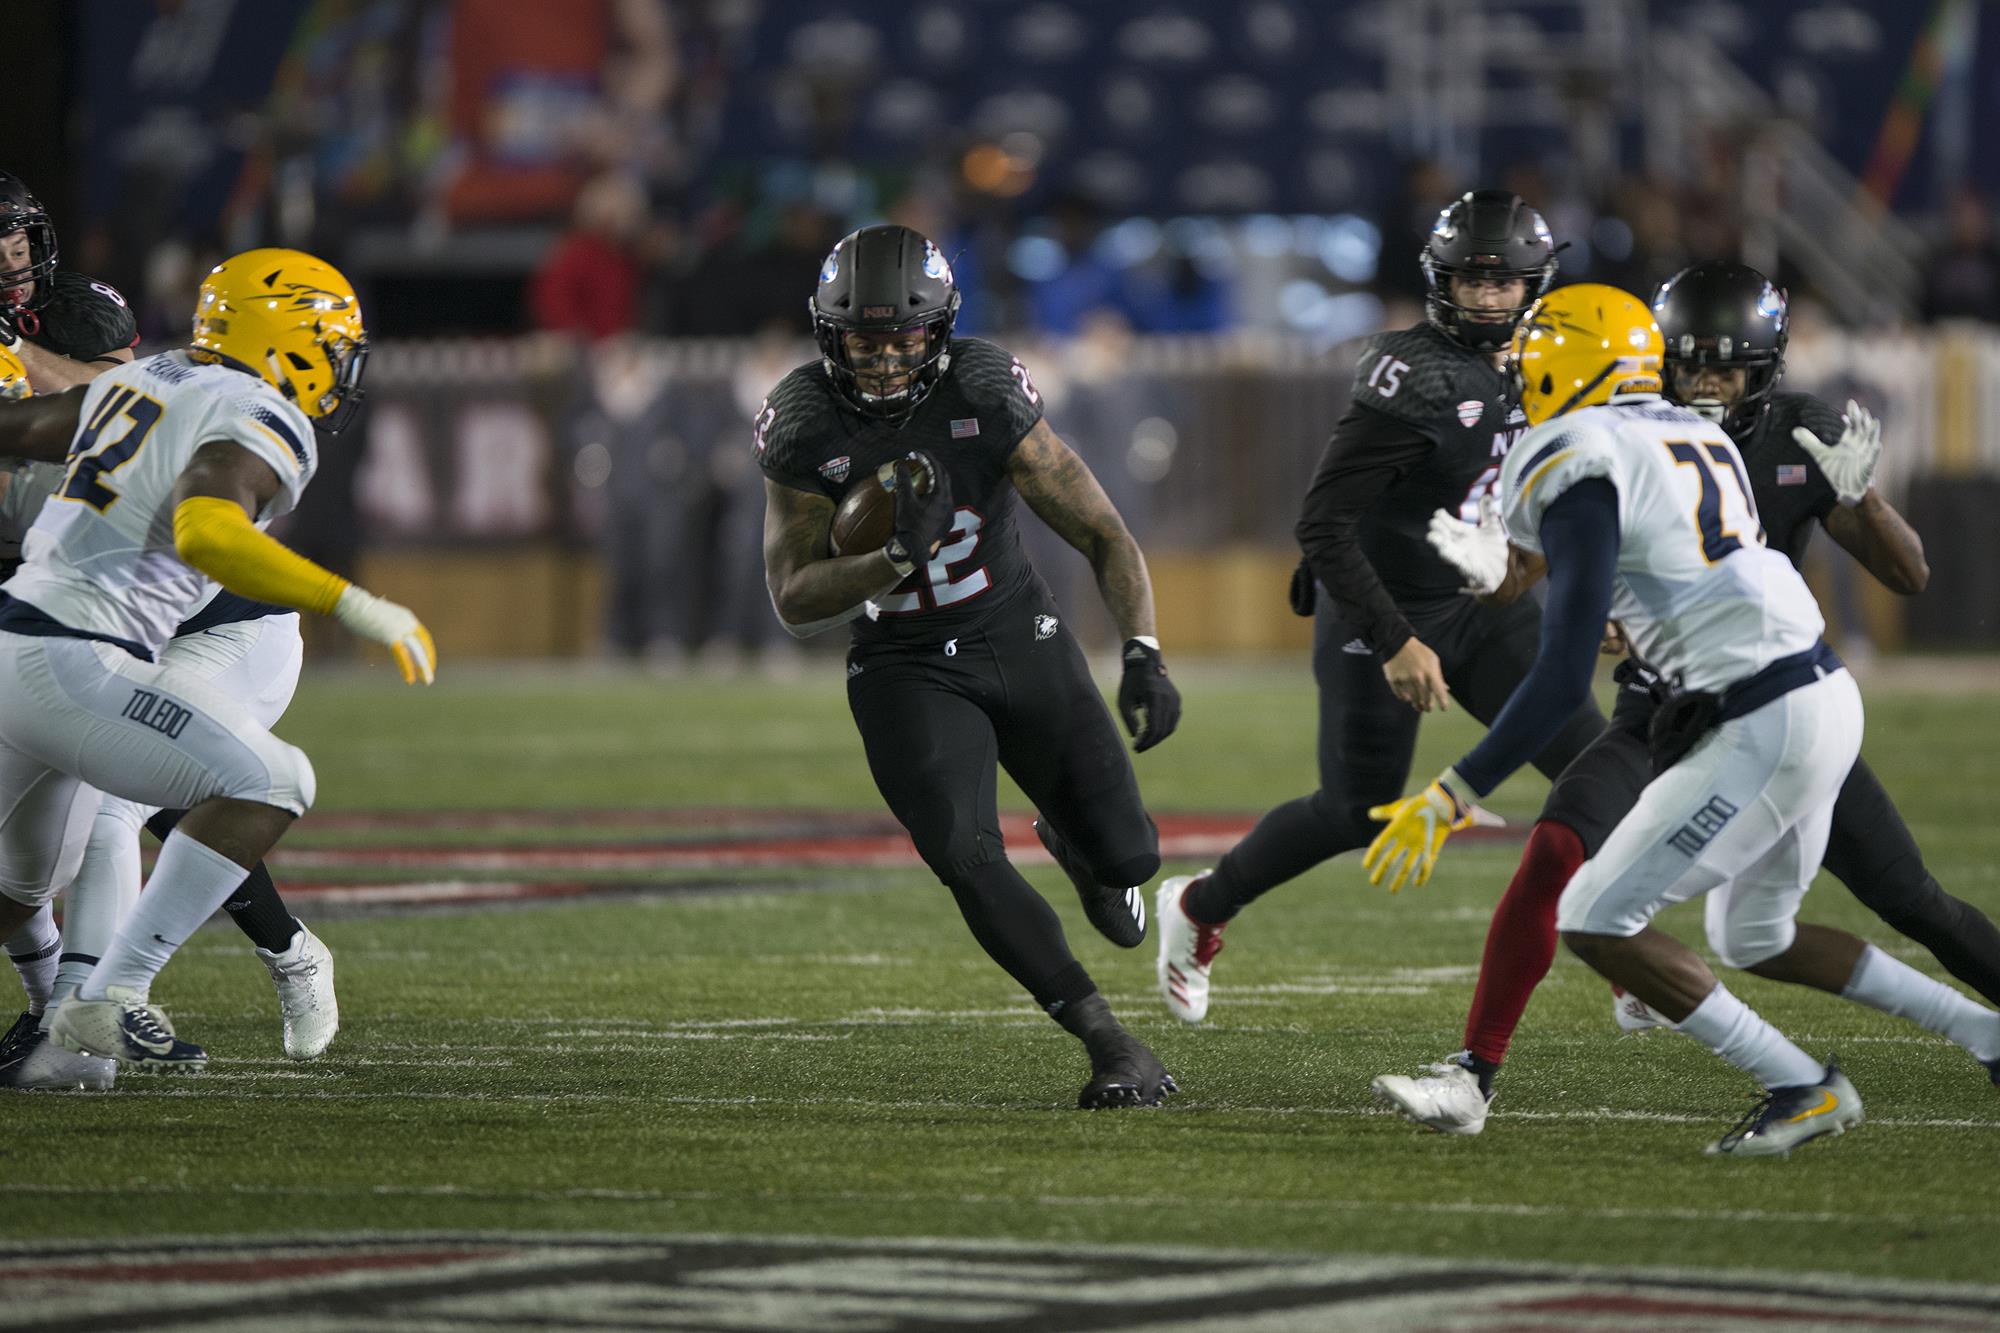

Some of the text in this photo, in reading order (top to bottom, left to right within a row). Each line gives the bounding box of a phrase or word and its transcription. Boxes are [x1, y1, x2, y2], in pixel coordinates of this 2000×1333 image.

[90, 282, 127, 308] 8
[1009, 356, 1040, 406] 2
[1368, 355, 1411, 398] 15
[57, 381, 165, 516] 42
[121, 688, 193, 740] TOLEDO
[1666, 794, 1739, 859] TOLEDO
